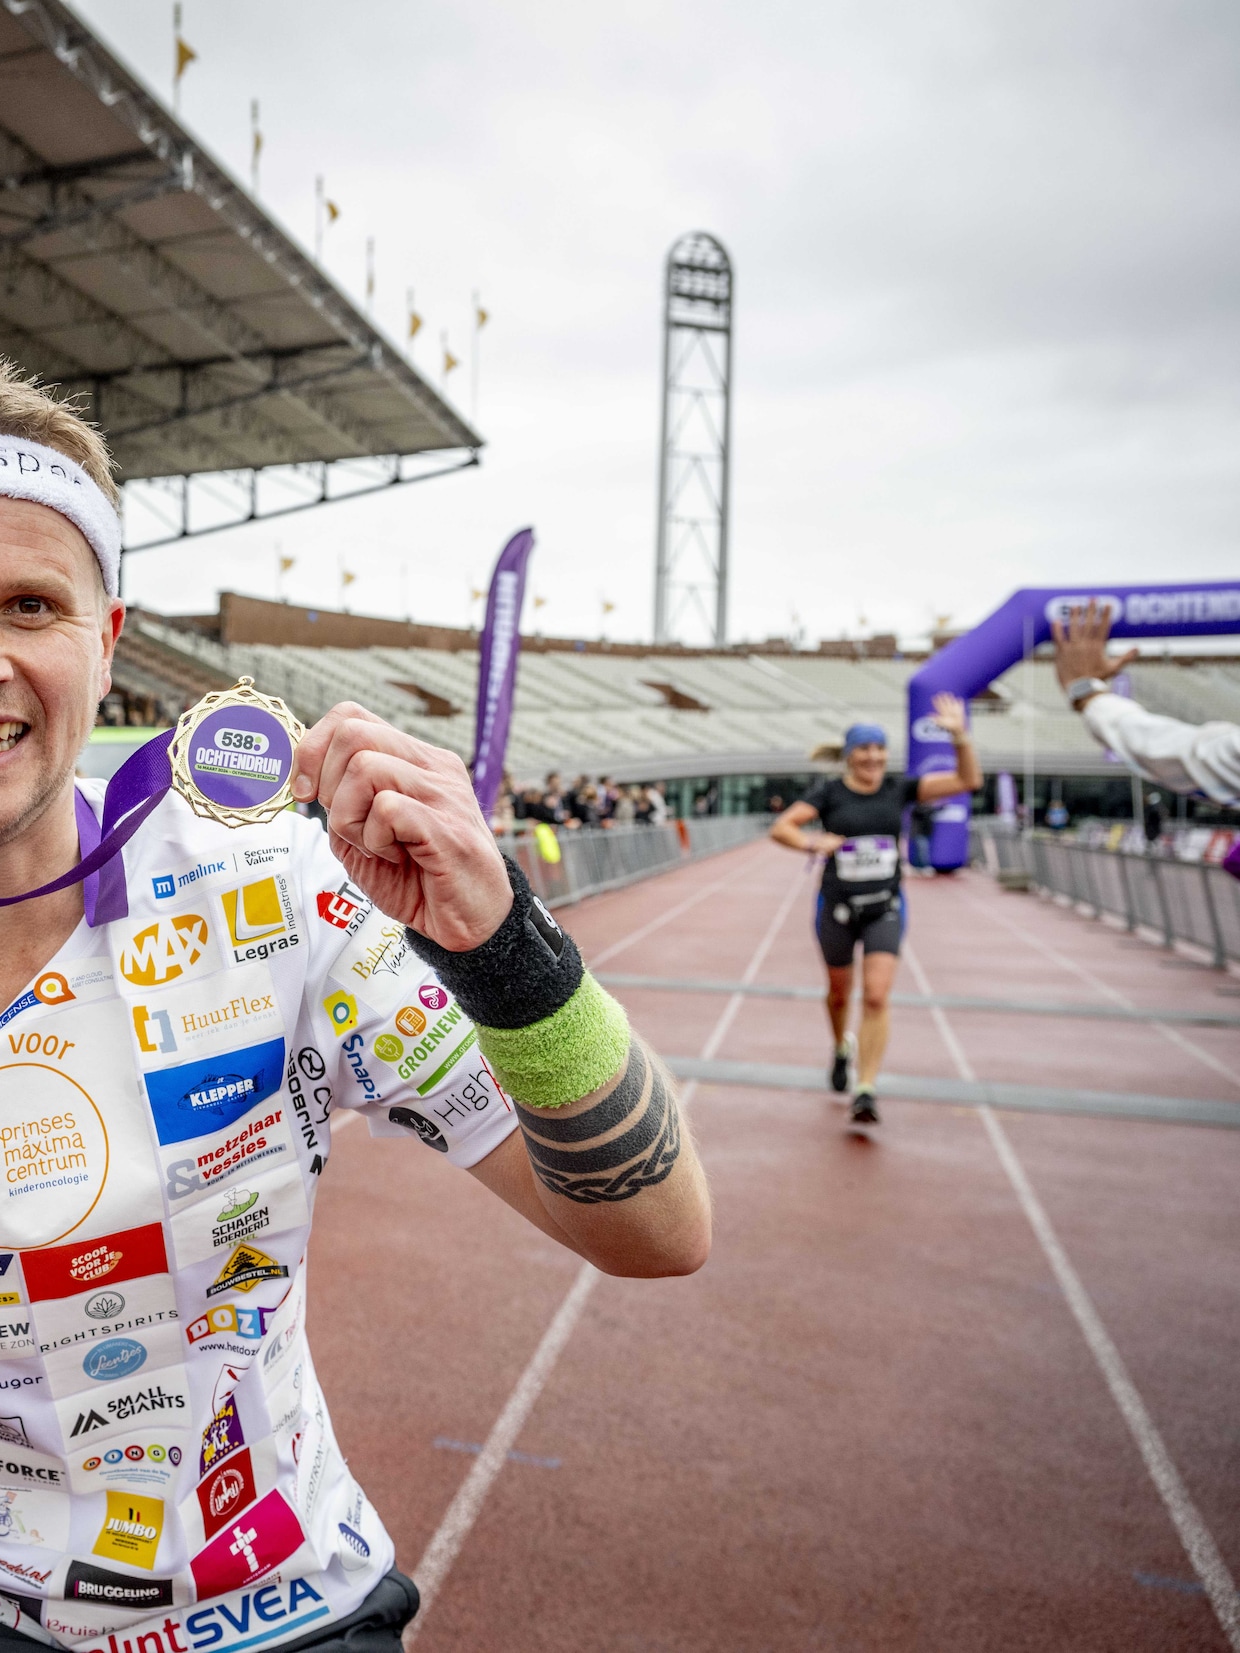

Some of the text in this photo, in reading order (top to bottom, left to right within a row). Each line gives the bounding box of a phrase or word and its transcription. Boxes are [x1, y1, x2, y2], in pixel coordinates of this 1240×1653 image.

[221, 731, 254, 750] 538
[195, 747, 282, 775] OCHTENDRUN
[244, 846, 289, 859] Securing
[245, 854, 274, 866] Value
[123, 917, 204, 980] MAX
[233, 933, 300, 963] Legras
[181, 994, 274, 1033] HuurFlex
[8, 1032, 75, 1060] voor
[190, 1078, 254, 1107] KLEPPER
[4, 1132, 86, 1166] máxima
[197, 1110, 283, 1167] metzelaar
[6, 1152, 88, 1183] centrum
[202, 1135, 267, 1180] vessies
[9, 1173, 89, 1197] kinderoncologie
[212, 1207, 269, 1238] SCHAPEN
[213, 1217, 270, 1247] BOERDERIJ
[69, 1251, 116, 1277] VOOR JE
[71, 1245, 108, 1268] SCOOR
[83, 1263, 110, 1281] CLUB
[209, 1268, 284, 1295] BOUWBESTEL.NL
[10, 1338, 35, 1349] ZON
[40, 1310, 179, 1352] RIGHTSPIRITS
[107, 1386, 166, 1413] SMALL
[116, 1395, 185, 1419] GIANTS
[106, 1518, 157, 1540] JUMBO
[77, 1580, 160, 1598] BRUGGELING
